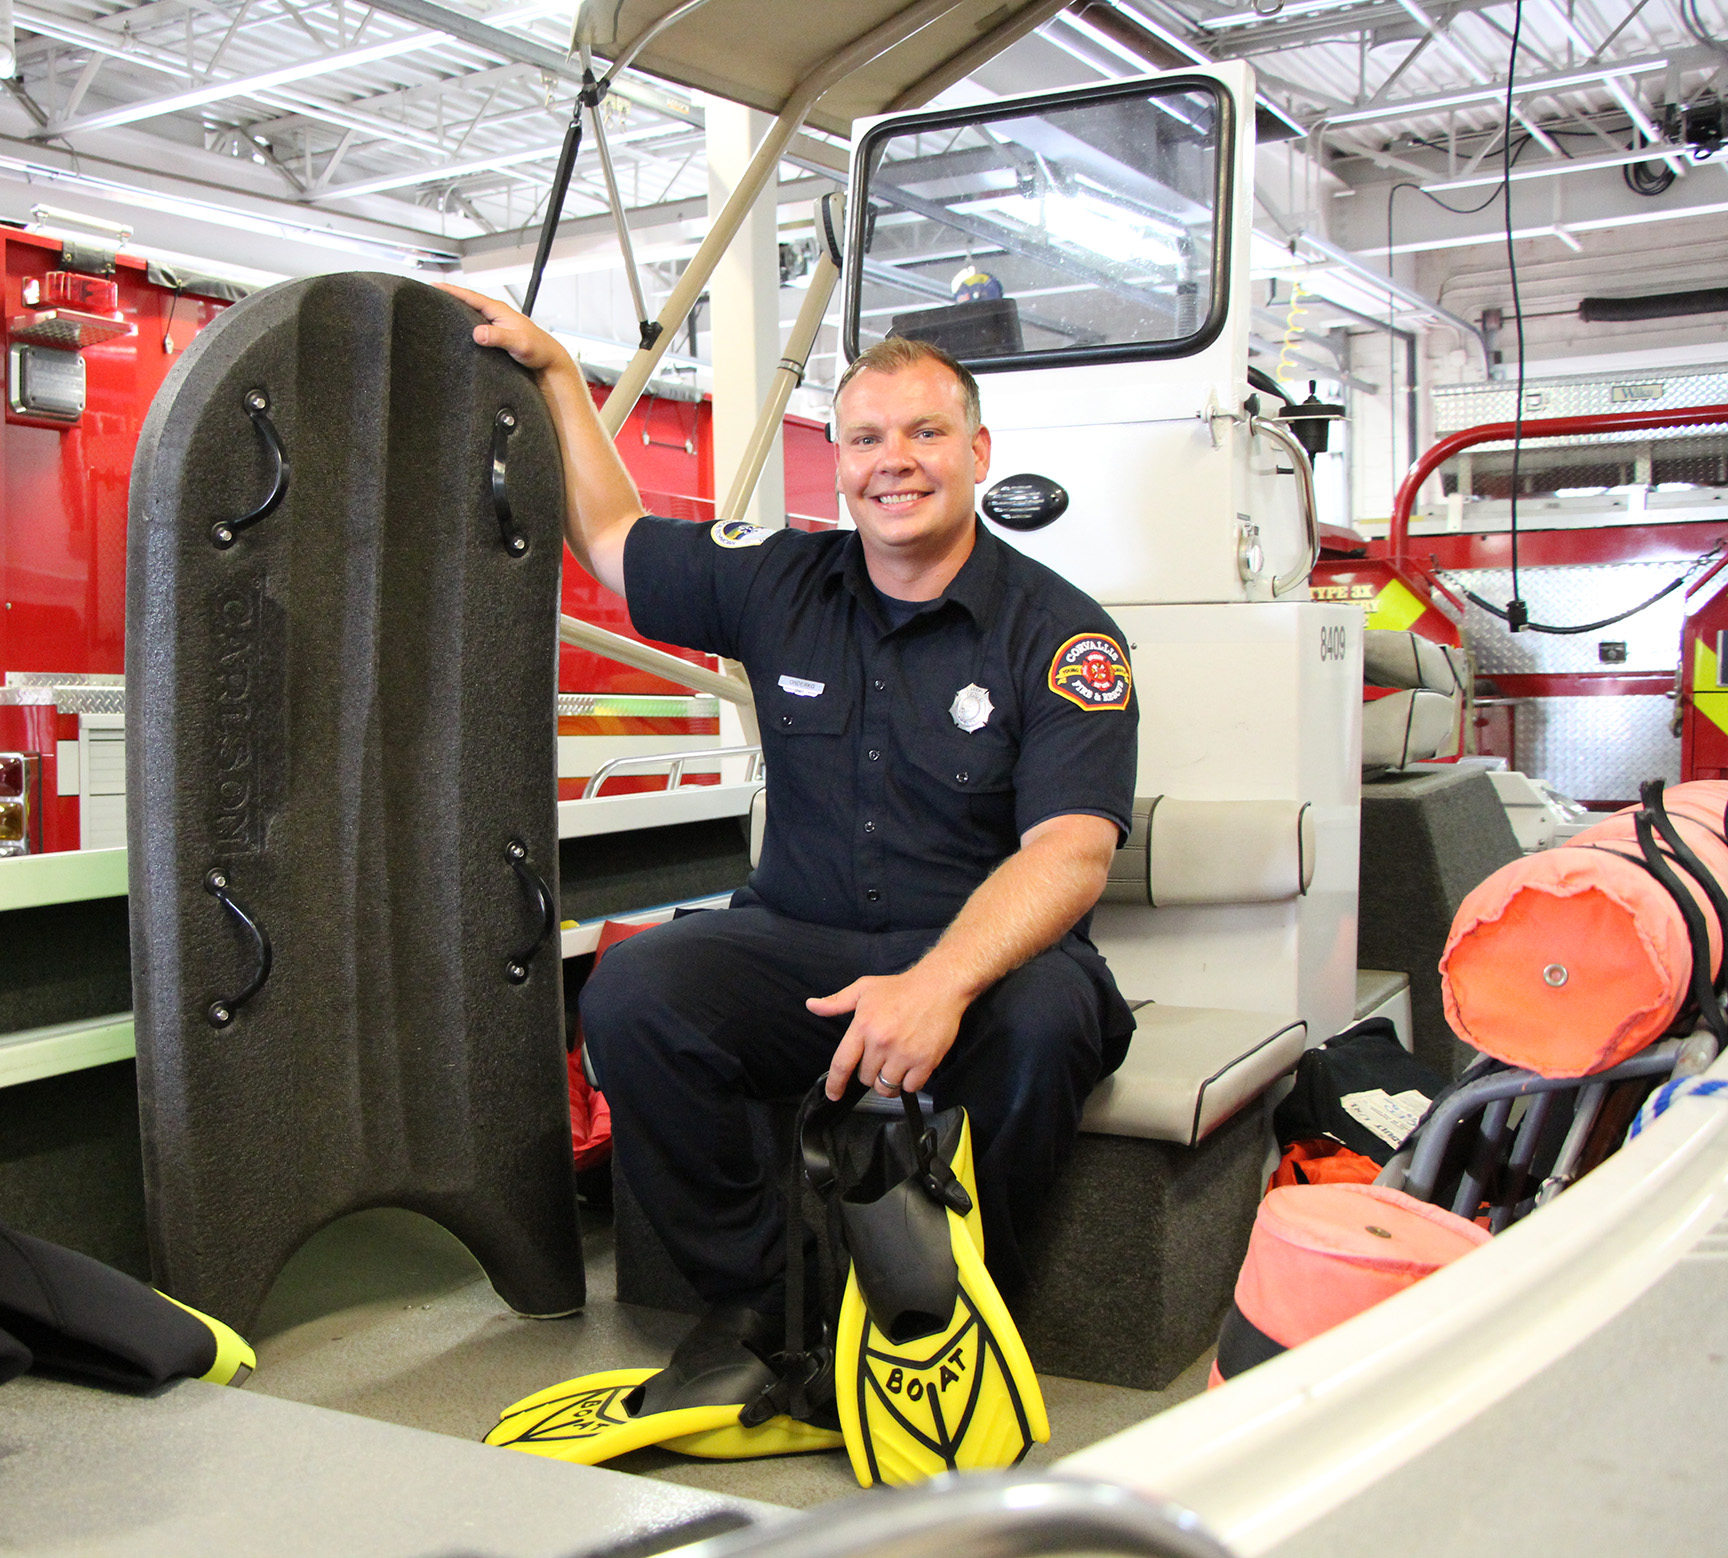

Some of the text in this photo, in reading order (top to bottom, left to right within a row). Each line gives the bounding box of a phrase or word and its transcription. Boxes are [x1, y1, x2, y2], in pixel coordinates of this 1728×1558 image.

[1351, 584, 1374, 599] 3X
[1066, 641, 1118, 662] CORVALLIS
[1320, 625, 1346, 662] 8409
[1071, 680, 1093, 699] FIRE
[1094, 692, 1102, 701] &
[214, 588, 252, 846] CARLSON
[885, 1347, 967, 1402] BOAT
[572, 1400, 611, 1431] BOAT
